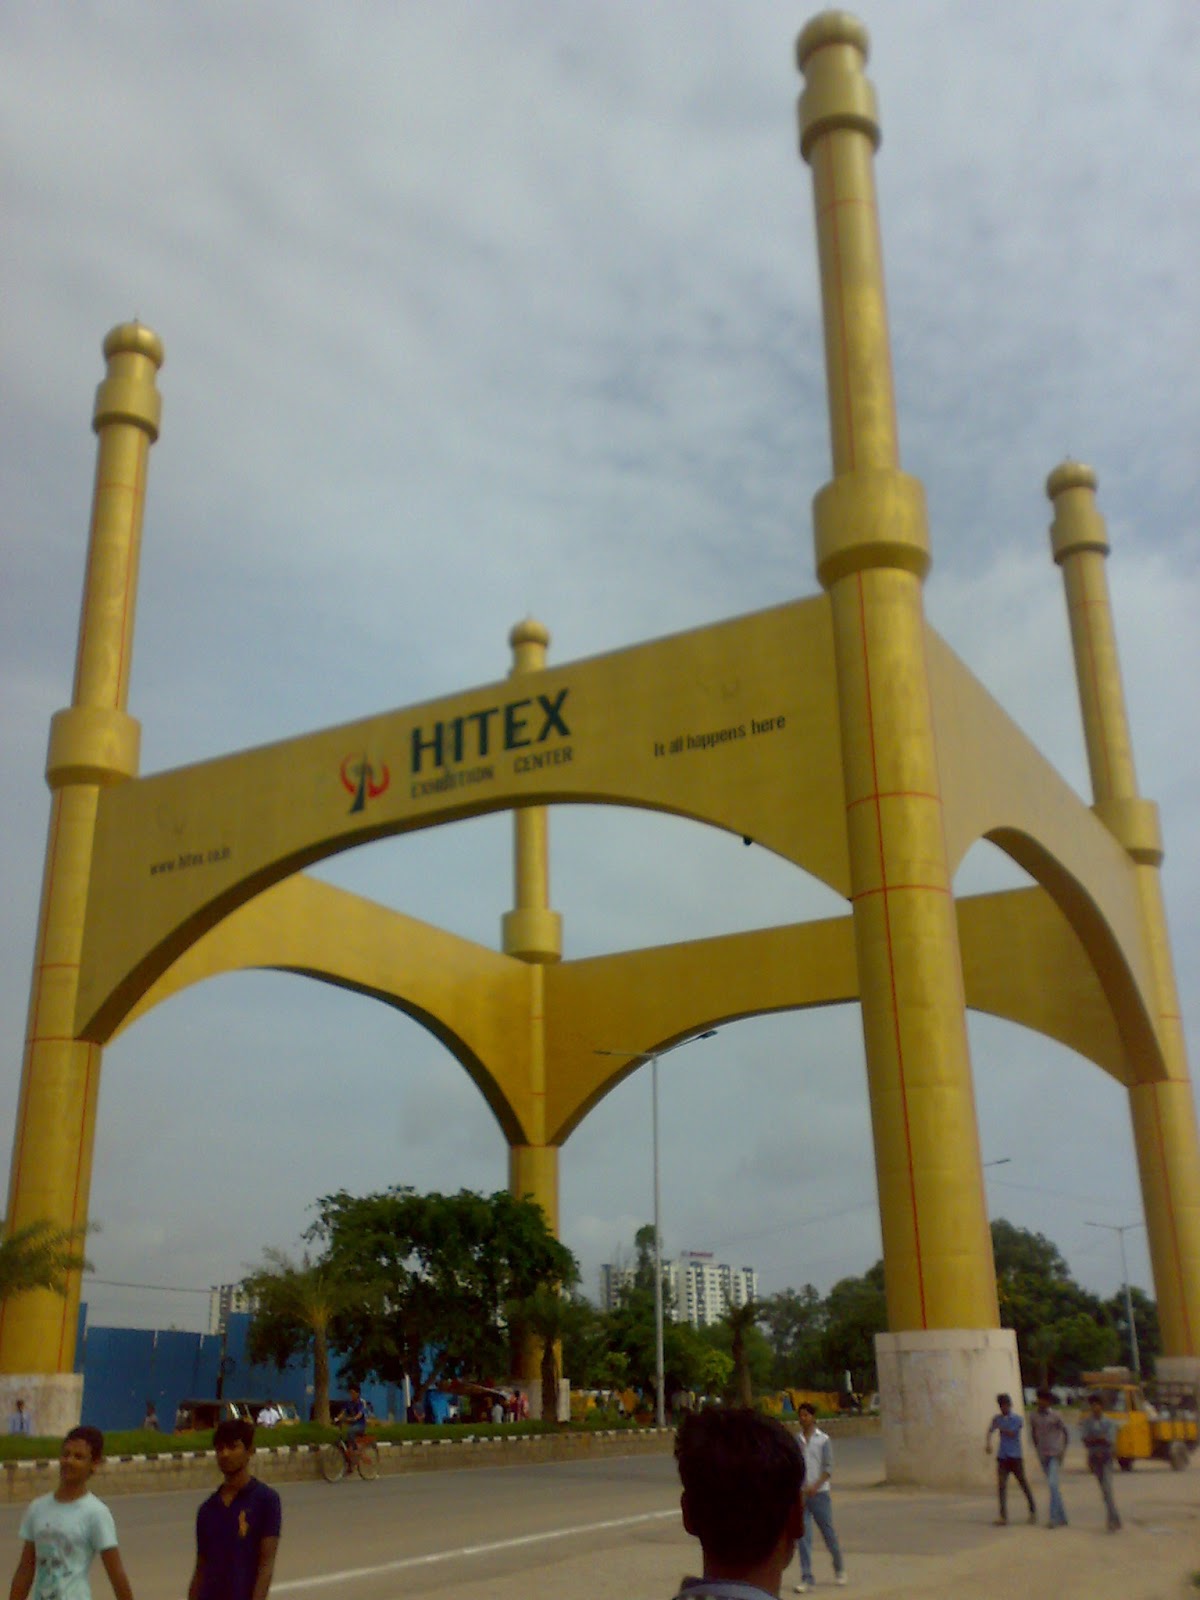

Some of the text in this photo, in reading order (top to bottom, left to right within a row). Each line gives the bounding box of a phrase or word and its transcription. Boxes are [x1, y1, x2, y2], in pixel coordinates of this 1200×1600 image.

[411, 688, 572, 773] HITEX
[669, 736, 683, 755] all
[687, 725, 746, 750] happens
[751, 715, 786, 735] here
[514, 747, 573, 774] CENTER
